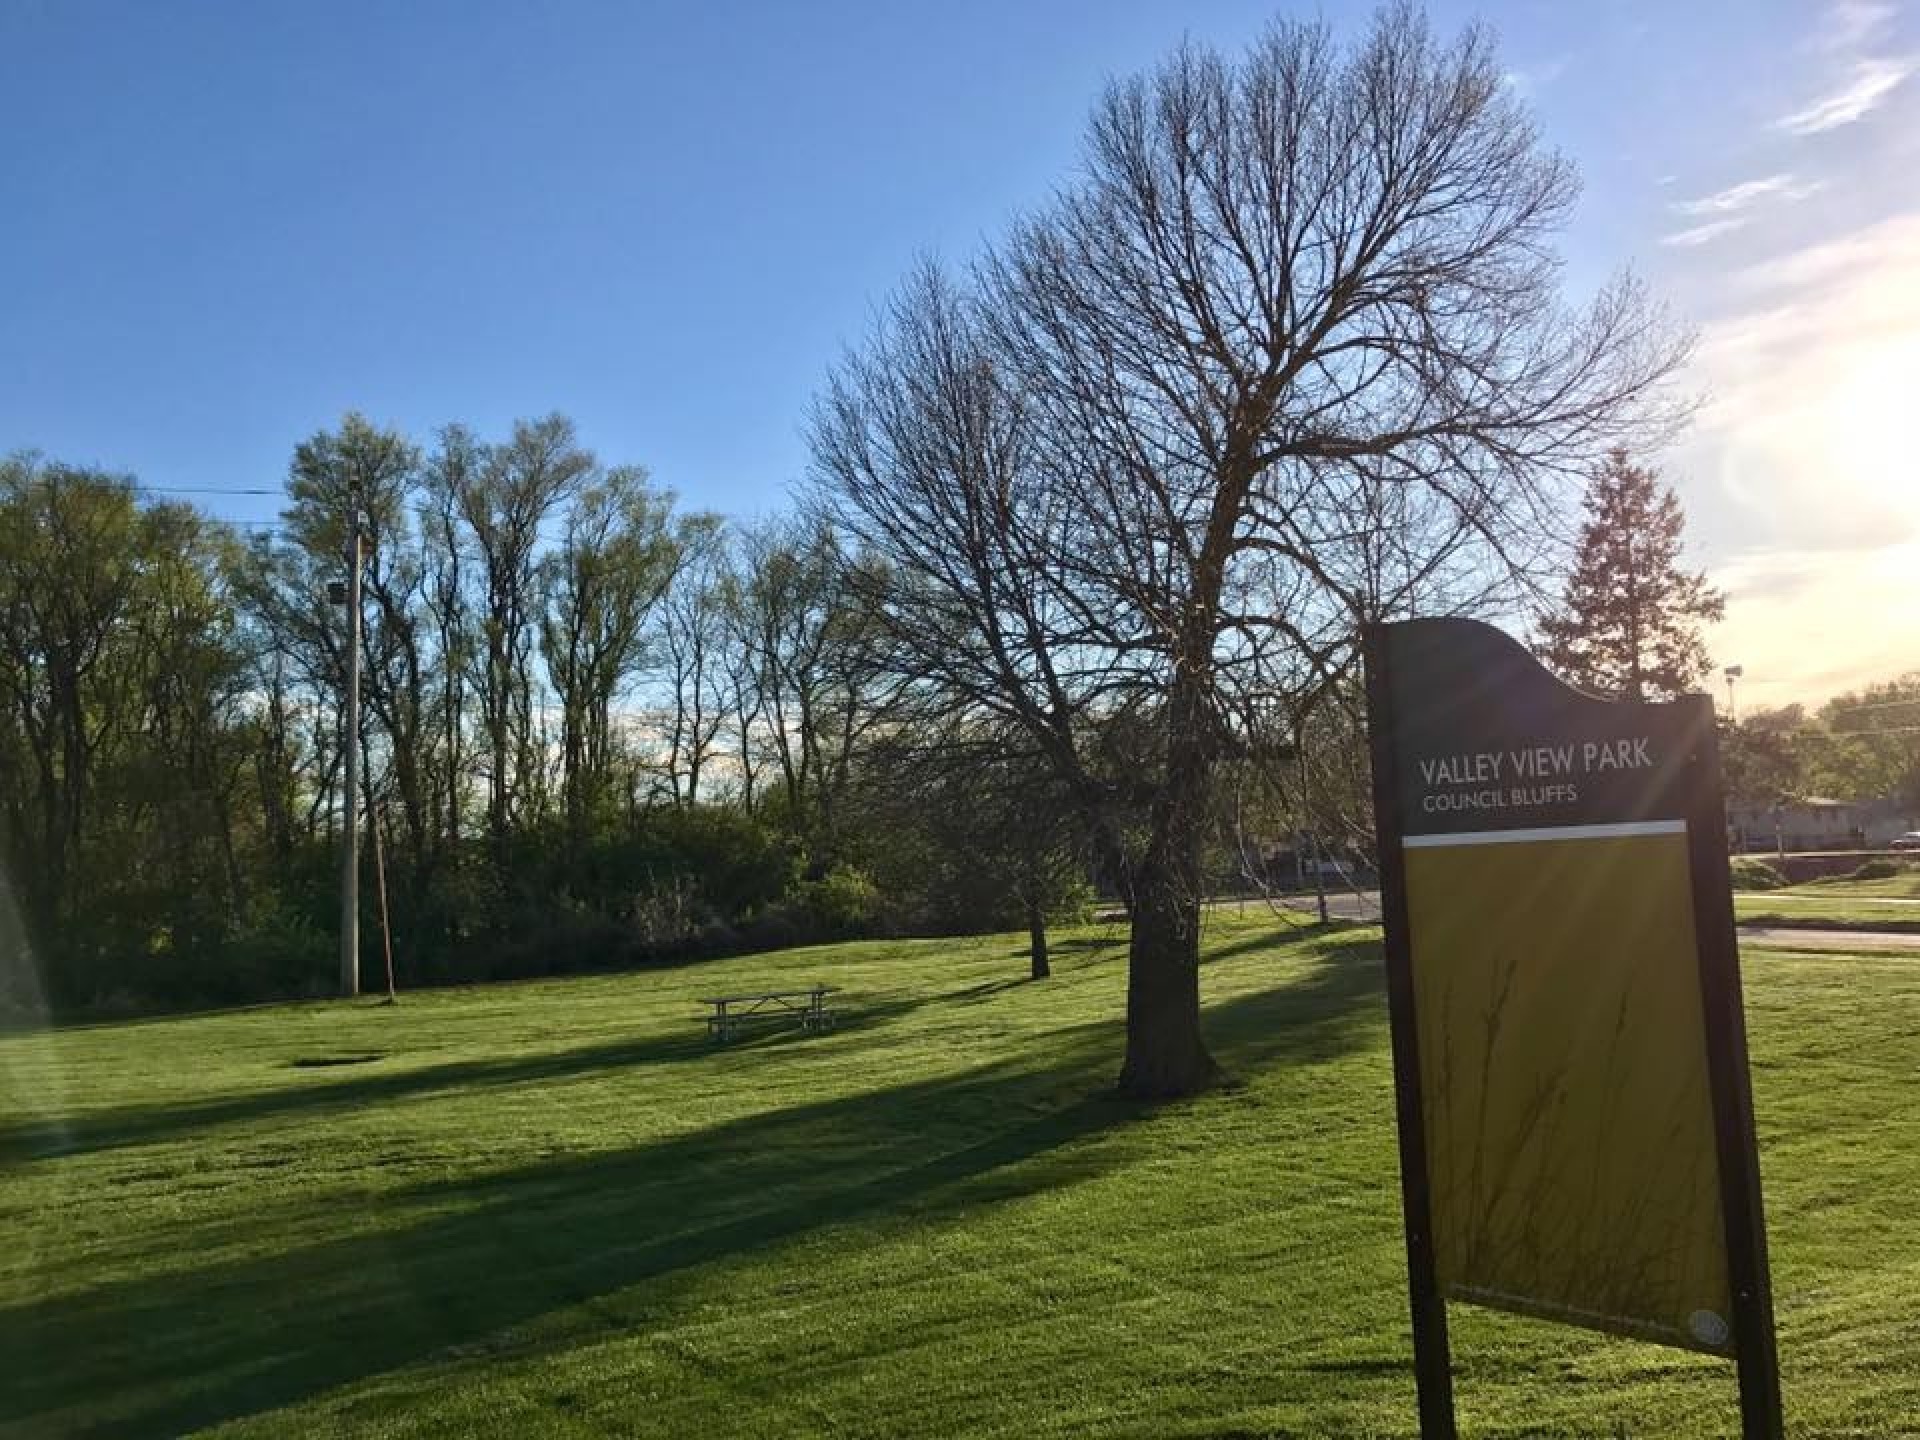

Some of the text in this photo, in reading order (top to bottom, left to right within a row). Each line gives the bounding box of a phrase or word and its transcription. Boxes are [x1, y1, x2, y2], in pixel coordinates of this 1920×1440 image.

[1420, 735, 1653, 785] VALLEY VIEW PARK
[1423, 784, 1578, 814] COUNCIL BLUFFS
